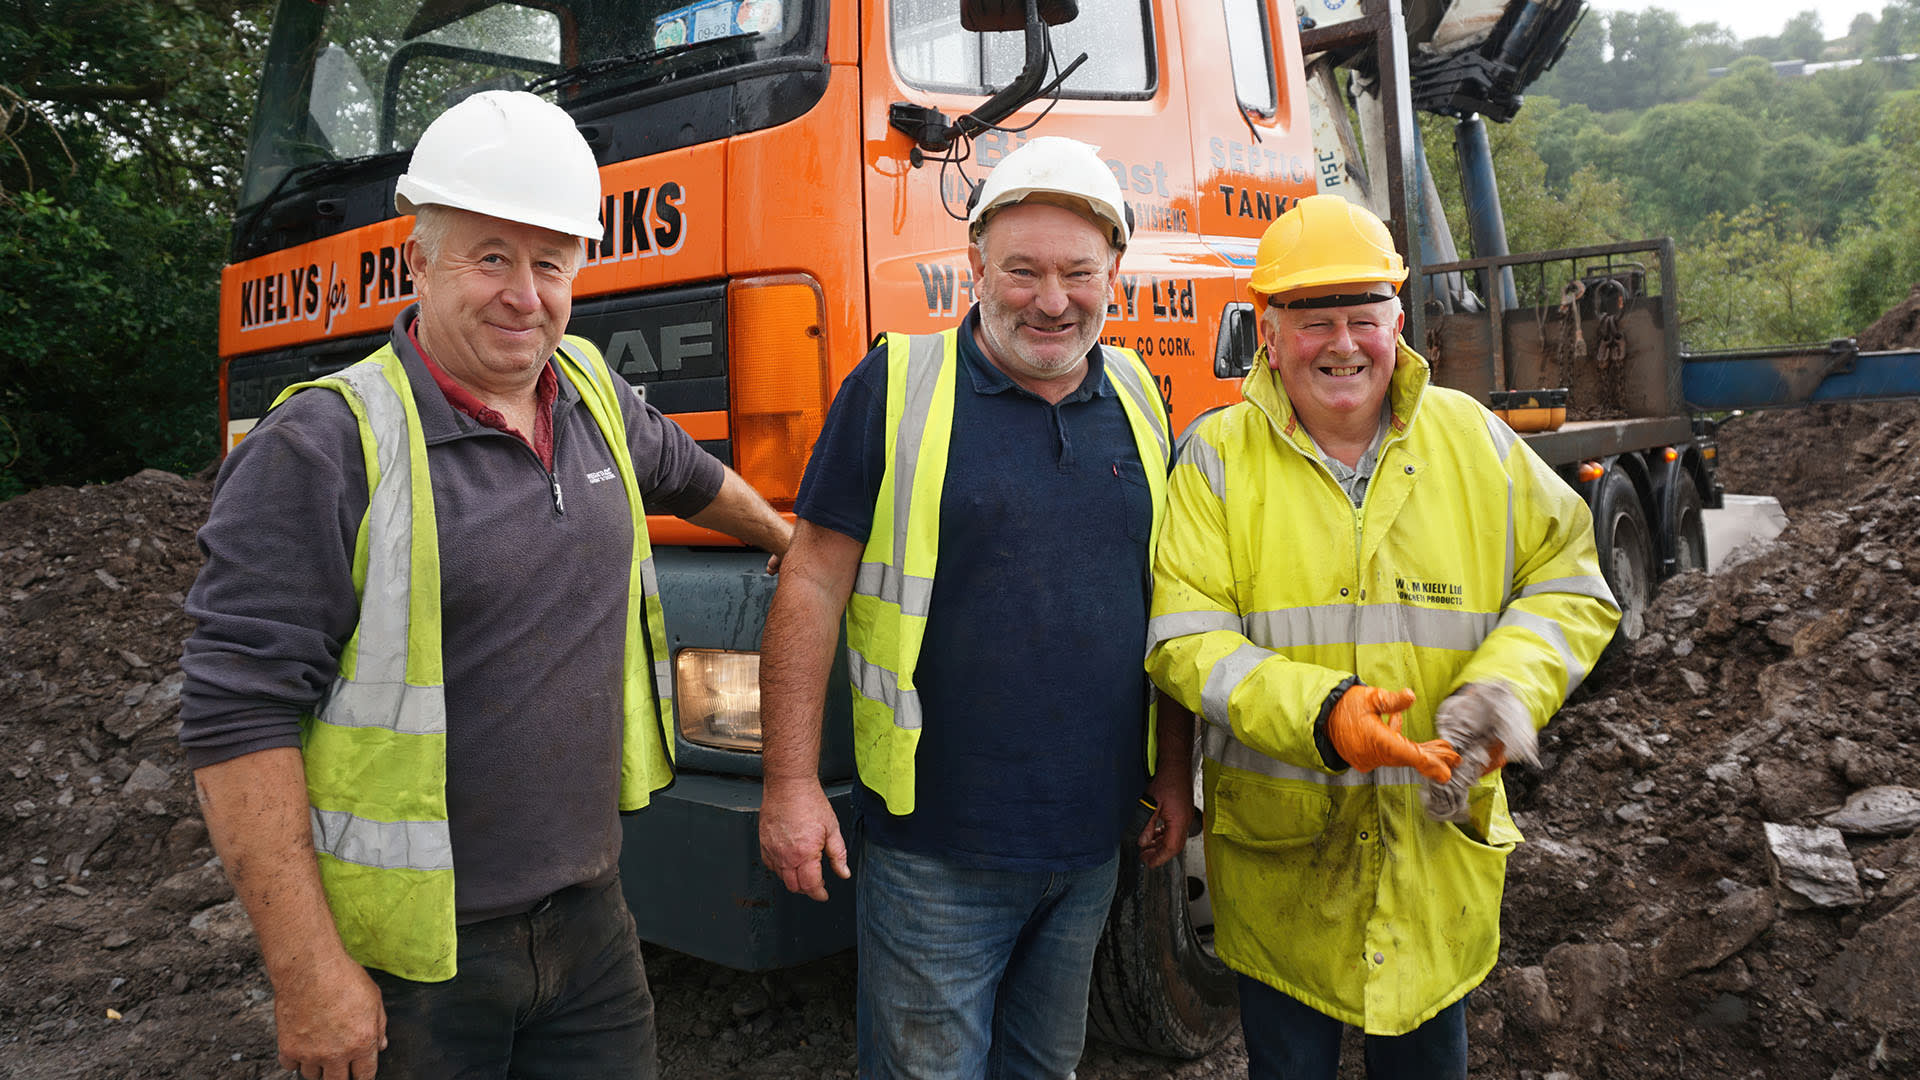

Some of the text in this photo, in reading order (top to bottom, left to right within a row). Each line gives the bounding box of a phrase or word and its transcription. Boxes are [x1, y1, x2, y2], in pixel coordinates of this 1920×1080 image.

[697, 24, 727, 40] 09-23
[1209, 136, 1305, 184] SEPTIC
[1136, 202, 1188, 232] SYSTEMS
[241, 264, 321, 331] KIELYS
[325, 261, 349, 334] for
[1152, 275, 1197, 322] Ltd
[605, 321, 712, 374] AF
[1137, 336, 1153, 356] CO
[1159, 336, 1195, 356] CORK.
[1422, 583, 1447, 594] KIELY
[1450, 584, 1462, 595] Ltd
[1427, 595, 1463, 605] PRODUCTS
